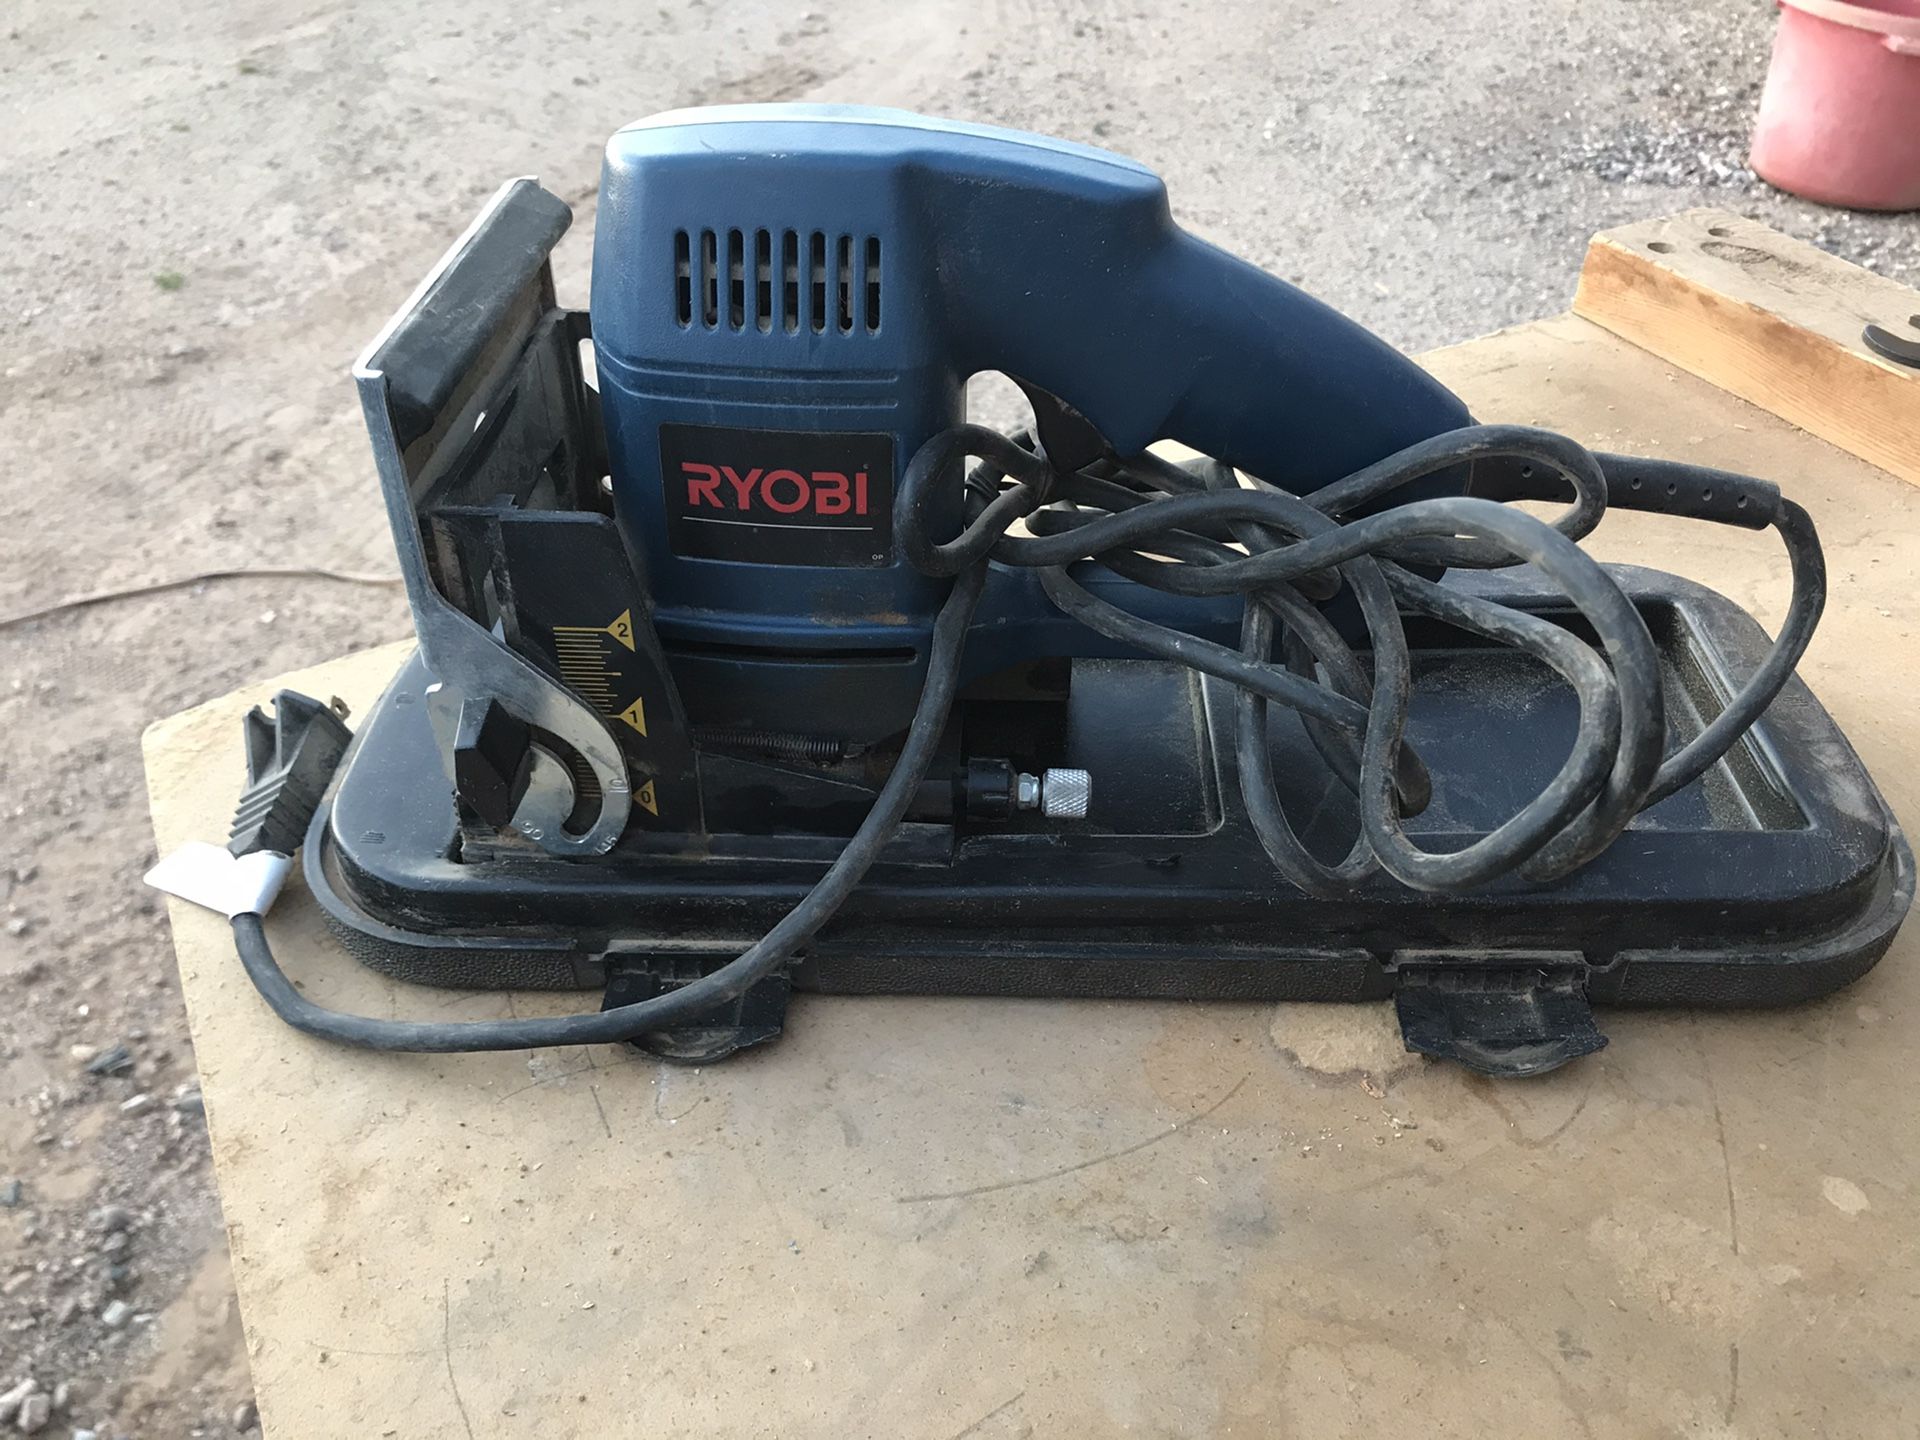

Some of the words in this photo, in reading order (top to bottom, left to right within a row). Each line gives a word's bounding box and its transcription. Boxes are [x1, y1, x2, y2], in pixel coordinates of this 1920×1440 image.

[681, 462, 868, 515] RYOBI
[618, 623, 629, 637] 2
[630, 711, 638, 724] 1
[641, 790, 651, 803] 0
